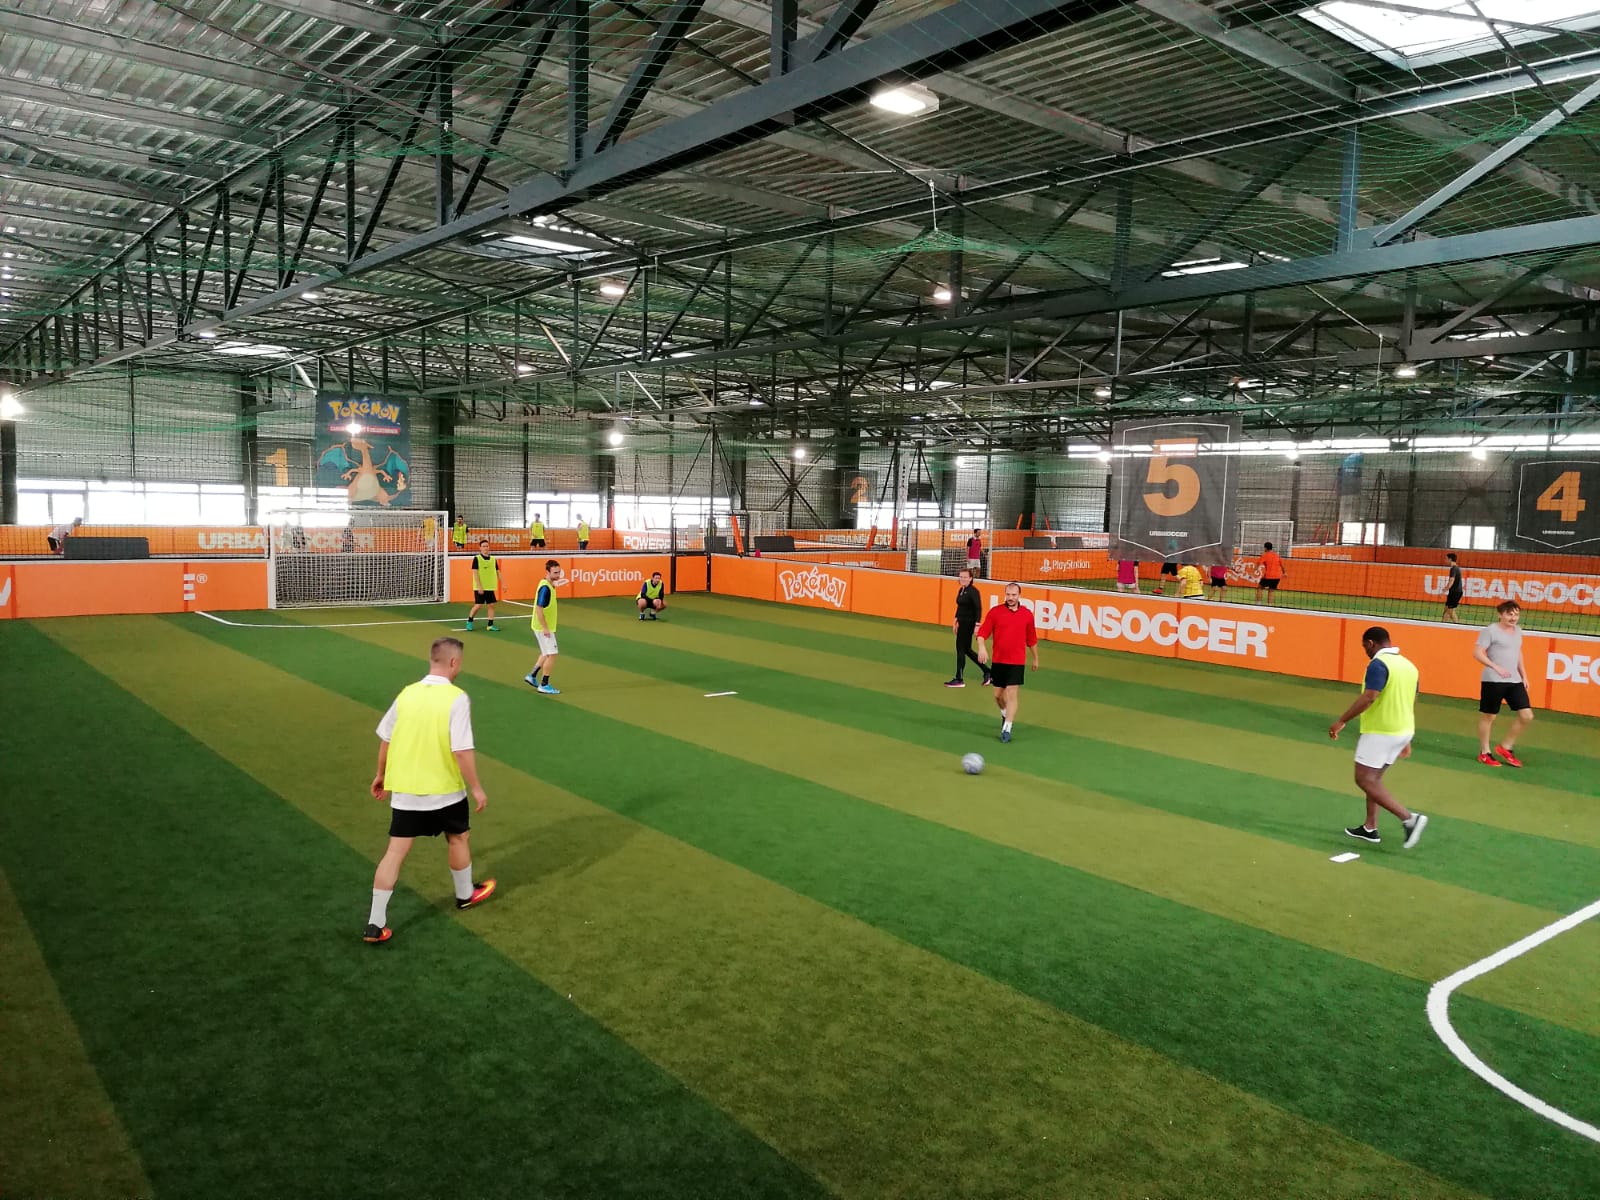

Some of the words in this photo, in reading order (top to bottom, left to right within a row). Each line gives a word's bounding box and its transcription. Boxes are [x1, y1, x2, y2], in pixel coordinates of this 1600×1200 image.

[265, 447, 288, 487] 1
[1143, 437, 1201, 516] 5
[850, 476, 869, 504] 2
[1536, 471, 1586, 522] 4
[570, 568, 642, 586] PlayStation
[1052, 559, 1090, 571] PlayStation
[1424, 574, 1600, 606] UBANSOC
[989, 595, 1269, 658] BANSOCCER
